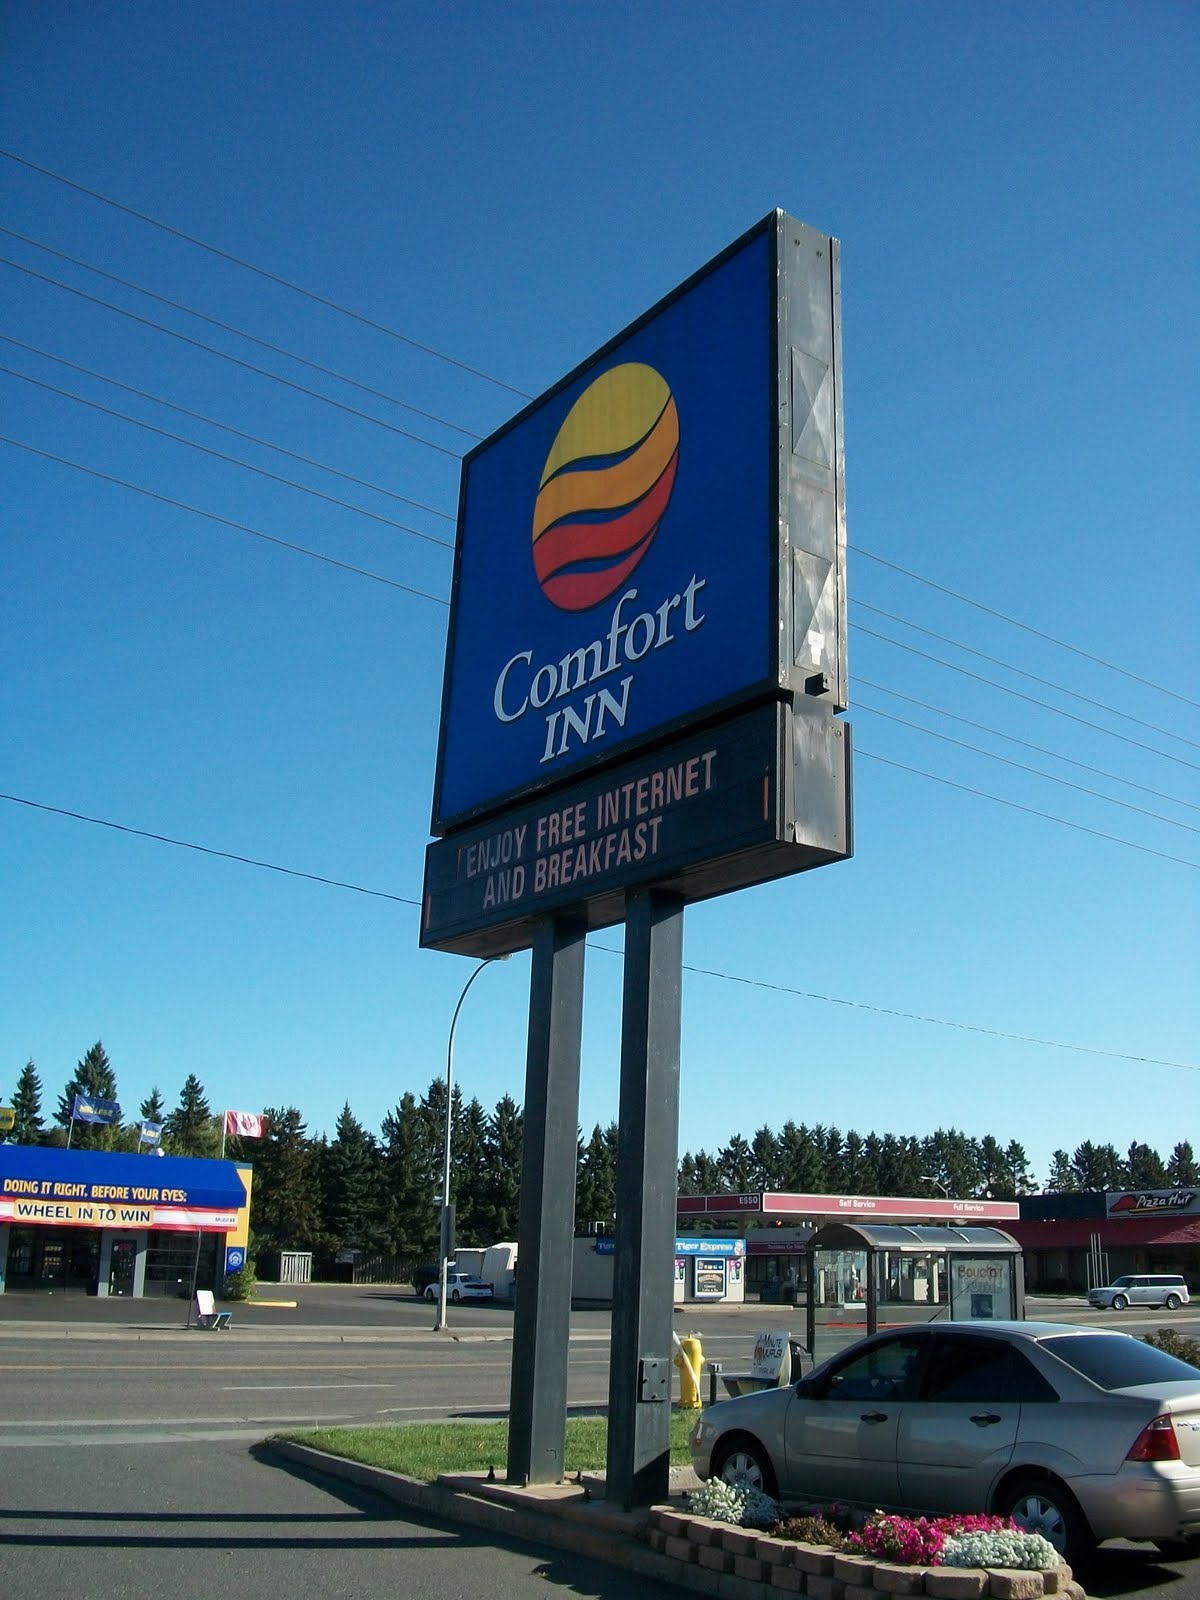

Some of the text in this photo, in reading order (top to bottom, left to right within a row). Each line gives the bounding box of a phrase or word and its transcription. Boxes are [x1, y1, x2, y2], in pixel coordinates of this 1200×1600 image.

[494, 573, 707, 723] Comfort
[539, 675, 634, 764] INN
[466, 750, 718, 879] ENJOY FREE INTERNET
[483, 816, 664, 909] AND BREAKFAST
[3, 1179, 39, 1194] DOING
[41, 1181, 52, 1194] IT
[53, 1182, 88, 1198] RIGHT.
[91, 1185, 129, 1200] BEFORE
[131, 1187, 159, 1201] YOUR
[739, 1196, 759, 1205] ESSO
[838, 1199, 876, 1209] Self Service
[953, 1203, 984, 1213] Full Service
[1135, 1192, 1196, 1209] Pizza Hut
[17, 1203, 150, 1222] WHEEL IN TO WIN
[676, 1242, 734, 1252] Tiger Express
